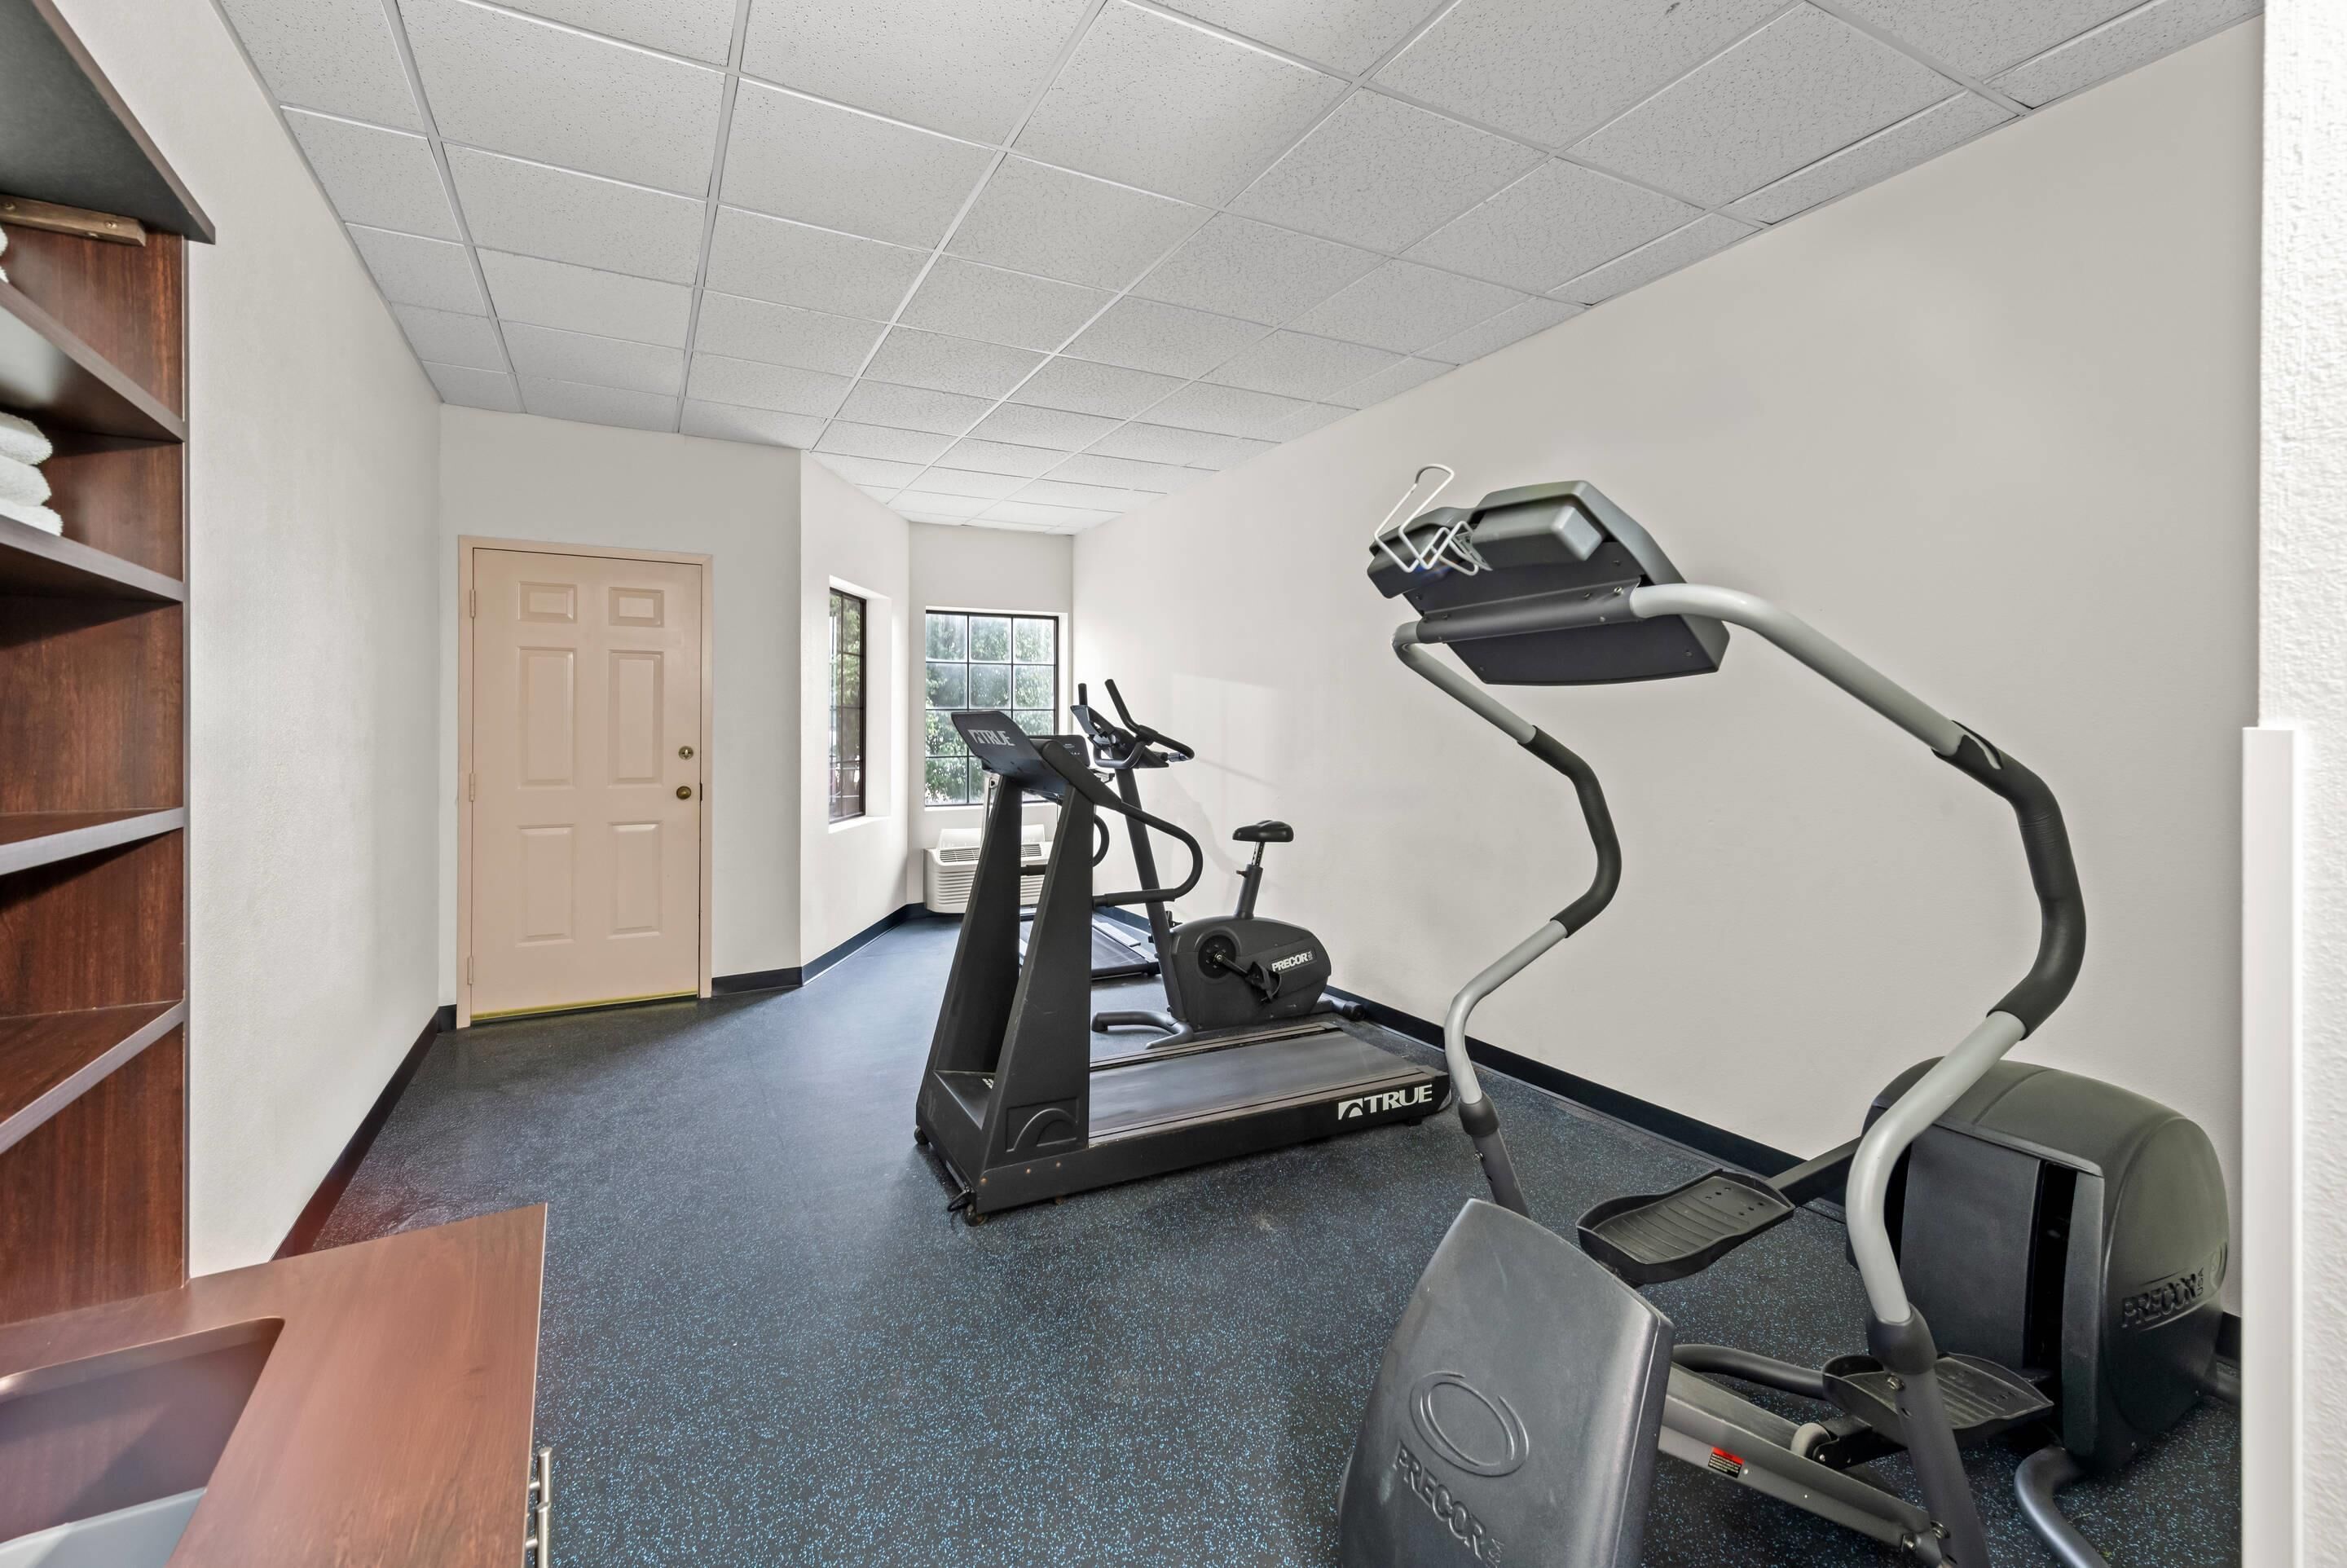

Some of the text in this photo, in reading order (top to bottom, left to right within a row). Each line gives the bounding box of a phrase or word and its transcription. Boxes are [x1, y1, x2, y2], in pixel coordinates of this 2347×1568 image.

[978, 729, 1015, 747] TRUE
[1271, 953, 1309, 972] PRECOR
[1363, 1084, 1433, 1114] TRUE
[2121, 1266, 2204, 1328] PRECOR USA
[1391, 1438, 1487, 1561] PRECOR
